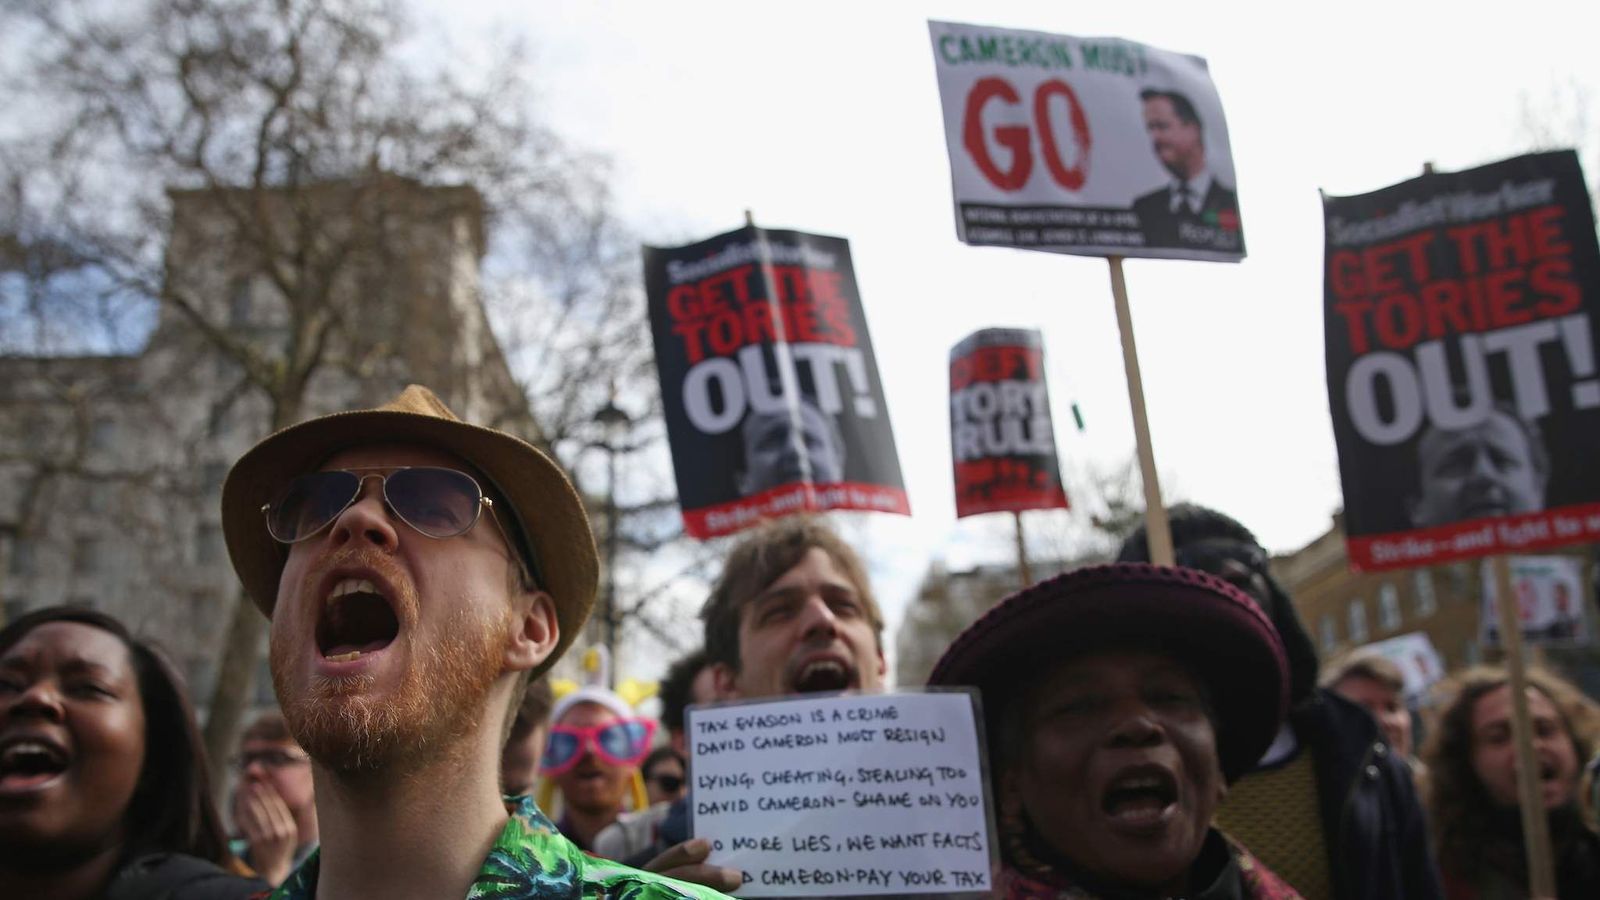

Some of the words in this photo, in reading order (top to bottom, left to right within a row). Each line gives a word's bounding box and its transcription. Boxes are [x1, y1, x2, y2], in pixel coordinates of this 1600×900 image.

[939, 34, 1074, 70] CAMERON
[962, 76, 1093, 193] GO
[1329, 231, 1435, 298] GET
[1447, 204, 1574, 277] THE
[667, 264, 754, 322] GET
[1334, 259, 1584, 355] TORIES
[672, 301, 857, 365] TORIES
[682, 341, 878, 435] OUT!
[1345, 312, 1600, 446] OUT!
[696, 720, 729, 734] TAX
[810, 708, 826, 723] IS
[831, 708, 842, 722] A
[846, 705, 899, 722] CRIME
[696, 738, 745, 756] DAVID
[752, 733, 829, 750] CAMERON
[883, 726, 946, 746] RESIGN
[857, 766, 935, 787] STEALING
[935, 765, 967, 780] TOO
[697, 799, 749, 815] DAVID
[852, 791, 913, 808] SHAME
[918, 794, 942, 807] ON
[945, 791, 980, 809] YOU
[731, 836, 783, 851] MORE
[846, 834, 876, 852] WE
[879, 832, 929, 849] WANT
[932, 831, 983, 852] FACTS
[897, 868, 948, 887] YOUR
[950, 870, 987, 888] TAX
